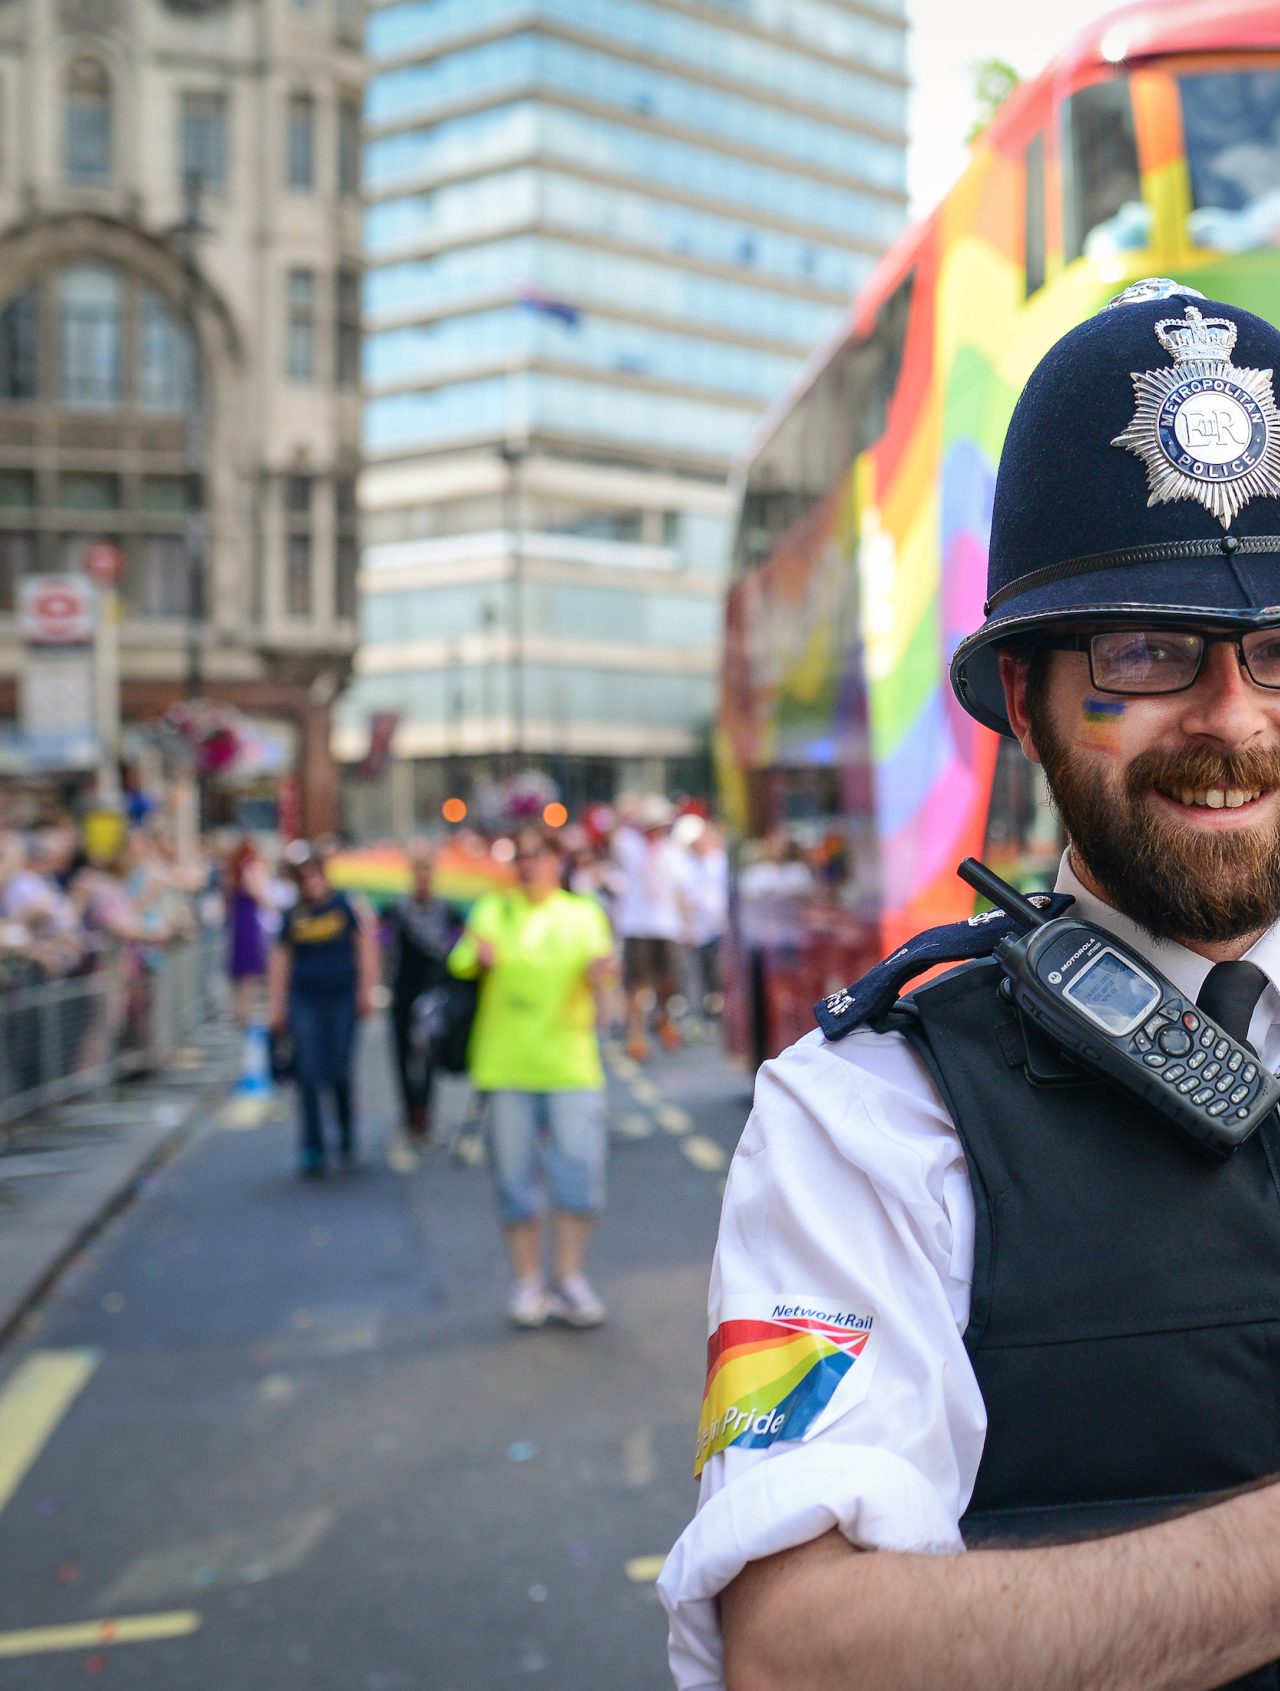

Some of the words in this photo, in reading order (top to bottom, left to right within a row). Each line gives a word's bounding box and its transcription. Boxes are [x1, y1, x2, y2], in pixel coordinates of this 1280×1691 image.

[1161, 378, 1262, 426] METROPOLITAN
[1177, 451, 1256, 478] POLICE
[1061, 938, 1096, 972] MOTOROLA
[722, 1406, 786, 1436] Pride
